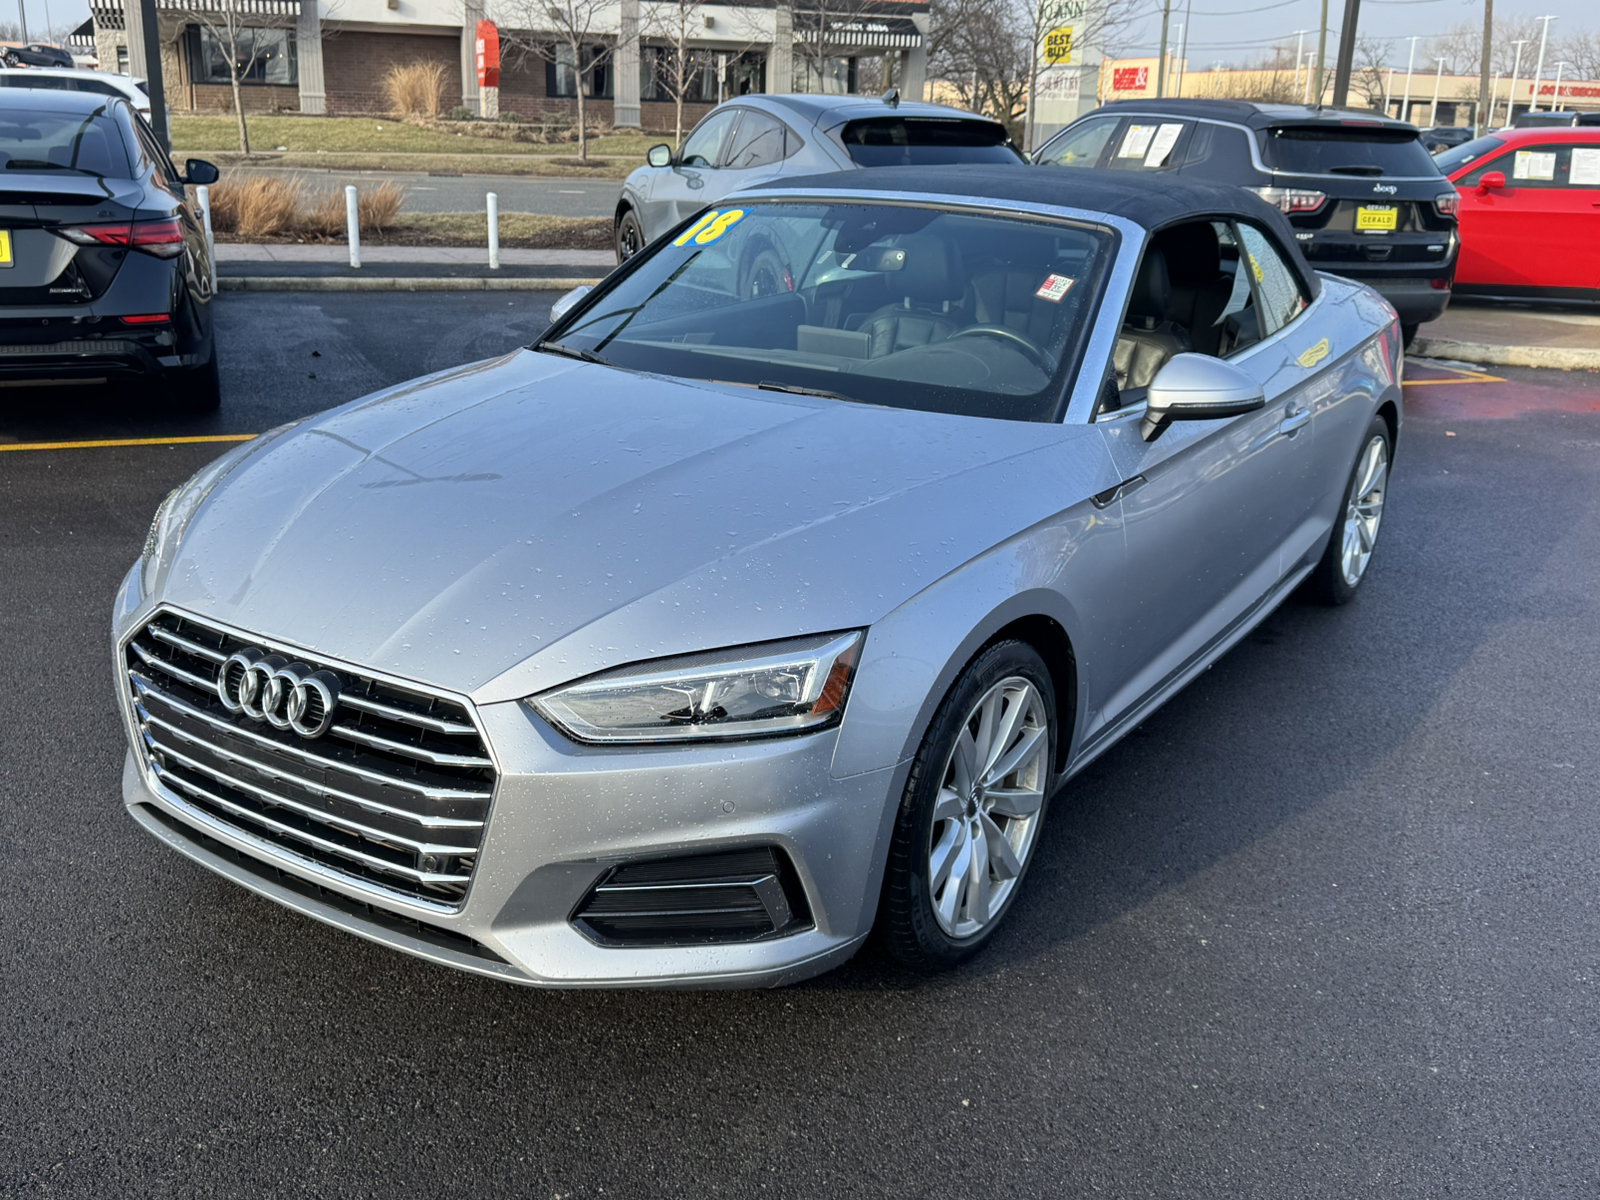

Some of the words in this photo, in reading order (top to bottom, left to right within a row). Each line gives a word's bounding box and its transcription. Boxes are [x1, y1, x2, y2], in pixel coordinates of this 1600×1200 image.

[1038, 1, 1085, 20] OANN
[1047, 34, 1071, 46] BEST
[1047, 47, 1066, 58] BUY
[1373, 183, 1397, 195] Jeep
[1362, 216, 1392, 224] GERALD
[672, 209, 745, 247] 18
